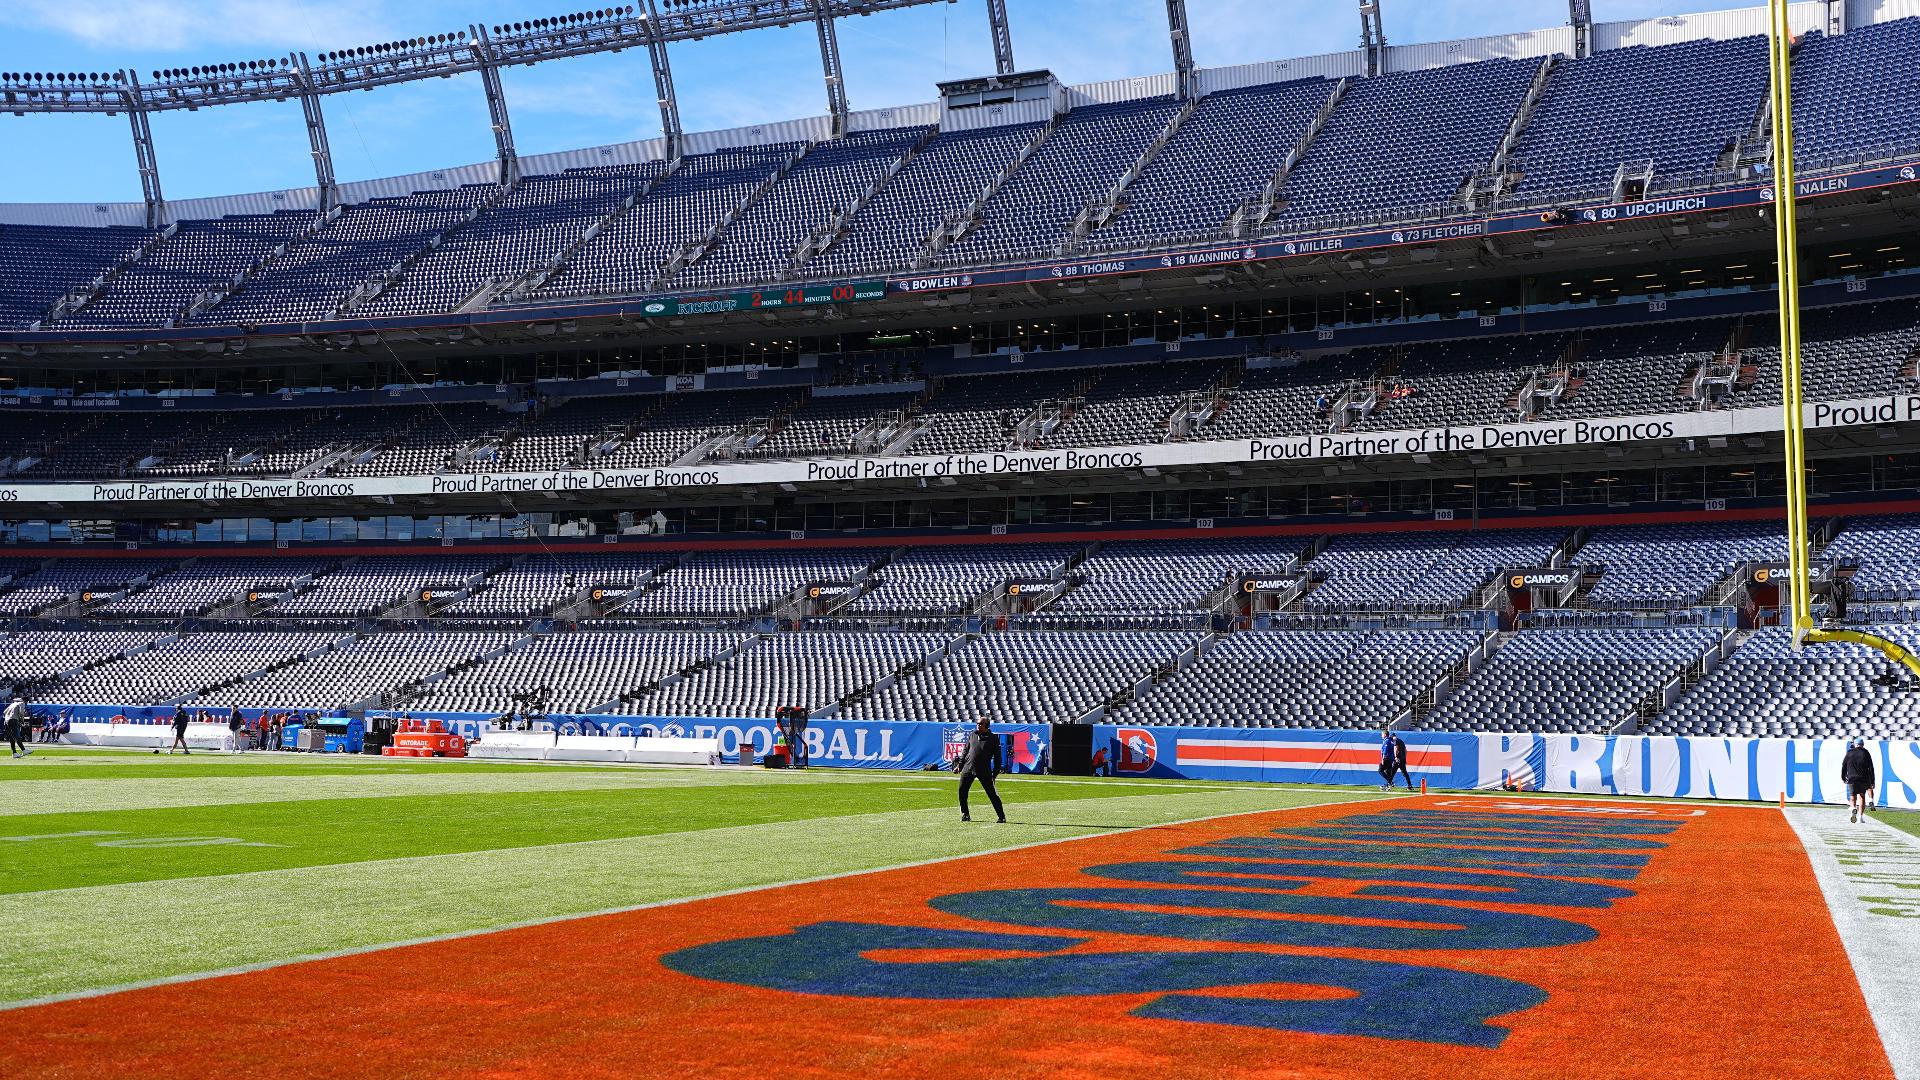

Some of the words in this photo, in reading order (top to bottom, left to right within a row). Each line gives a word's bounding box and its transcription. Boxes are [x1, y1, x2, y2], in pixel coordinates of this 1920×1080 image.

[1800, 178, 1848, 194] NALEN
[1601, 208, 1617, 219] 80
[1627, 197, 1706, 217] UPCHURCH
[1407, 230, 1420, 241] 73
[1423, 224, 1482, 240] FLETCHER
[1300, 239, 1342, 252] MILLER
[1175, 255, 1186, 265] 18
[1189, 250, 1240, 263] MANNING
[1065, 266, 1077, 276] 88
[1082, 261, 1125, 274] THOMAS
[912, 276, 958, 290] BOWLEN
[1847, 281, 1865, 291] 315
[677, 300, 737, 315] KICKOFF
[751, 293, 762, 307] 2
[784, 289, 804, 304] 44
[804, 295, 831, 303] MINUTES
[832, 285, 854, 300] 00
[855, 291, 884, 299] SECONDS
[1650, 301, 1666, 310] 314
[1320, 331, 1333, 339] 312
[1167, 343, 1179, 351] 311
[1815, 397, 1896, 427] Proud
[1250, 439, 1311, 459] Proud
[1320, 434, 1399, 457] Partner
[1406, 430, 1429, 453] of
[1435, 428, 1474, 451] the
[1483, 425, 1566, 448] Denver
[1575, 420, 1674, 439] Broncos
[808, 460, 858, 480] Proud
[865, 460, 928, 478] Partner
[934, 456, 954, 475] of
[957, 456, 987, 474] the
[994, 453, 1060, 472] Denver
[1067, 450, 1143, 469] Broncos
[433, 475, 477, 493] Proud
[482, 475, 537, 491] Partner
[542, 472, 559, 490] of
[563, 472, 587, 489] the
[593, 471, 649, 488] Denver
[655, 470, 718, 486] Broncos
[93, 484, 134, 500] Proud
[139, 484, 190, 500] Partner
[194, 482, 209, 499] of
[212, 482, 237, 499] the
[242, 481, 292, 497] Denver
[297, 481, 354, 497] Broncos
[1707, 501, 1724, 509] 109
[1524, 575, 1569, 584] CAMPOS
[1769, 568, 1820, 578] CAS
[1020, 584, 1053, 592] CAMPOS
[1256, 580, 1295, 589] CAMPOS
[449, 738, 459, 748] G
[694, 725, 904, 762] OOBALL
